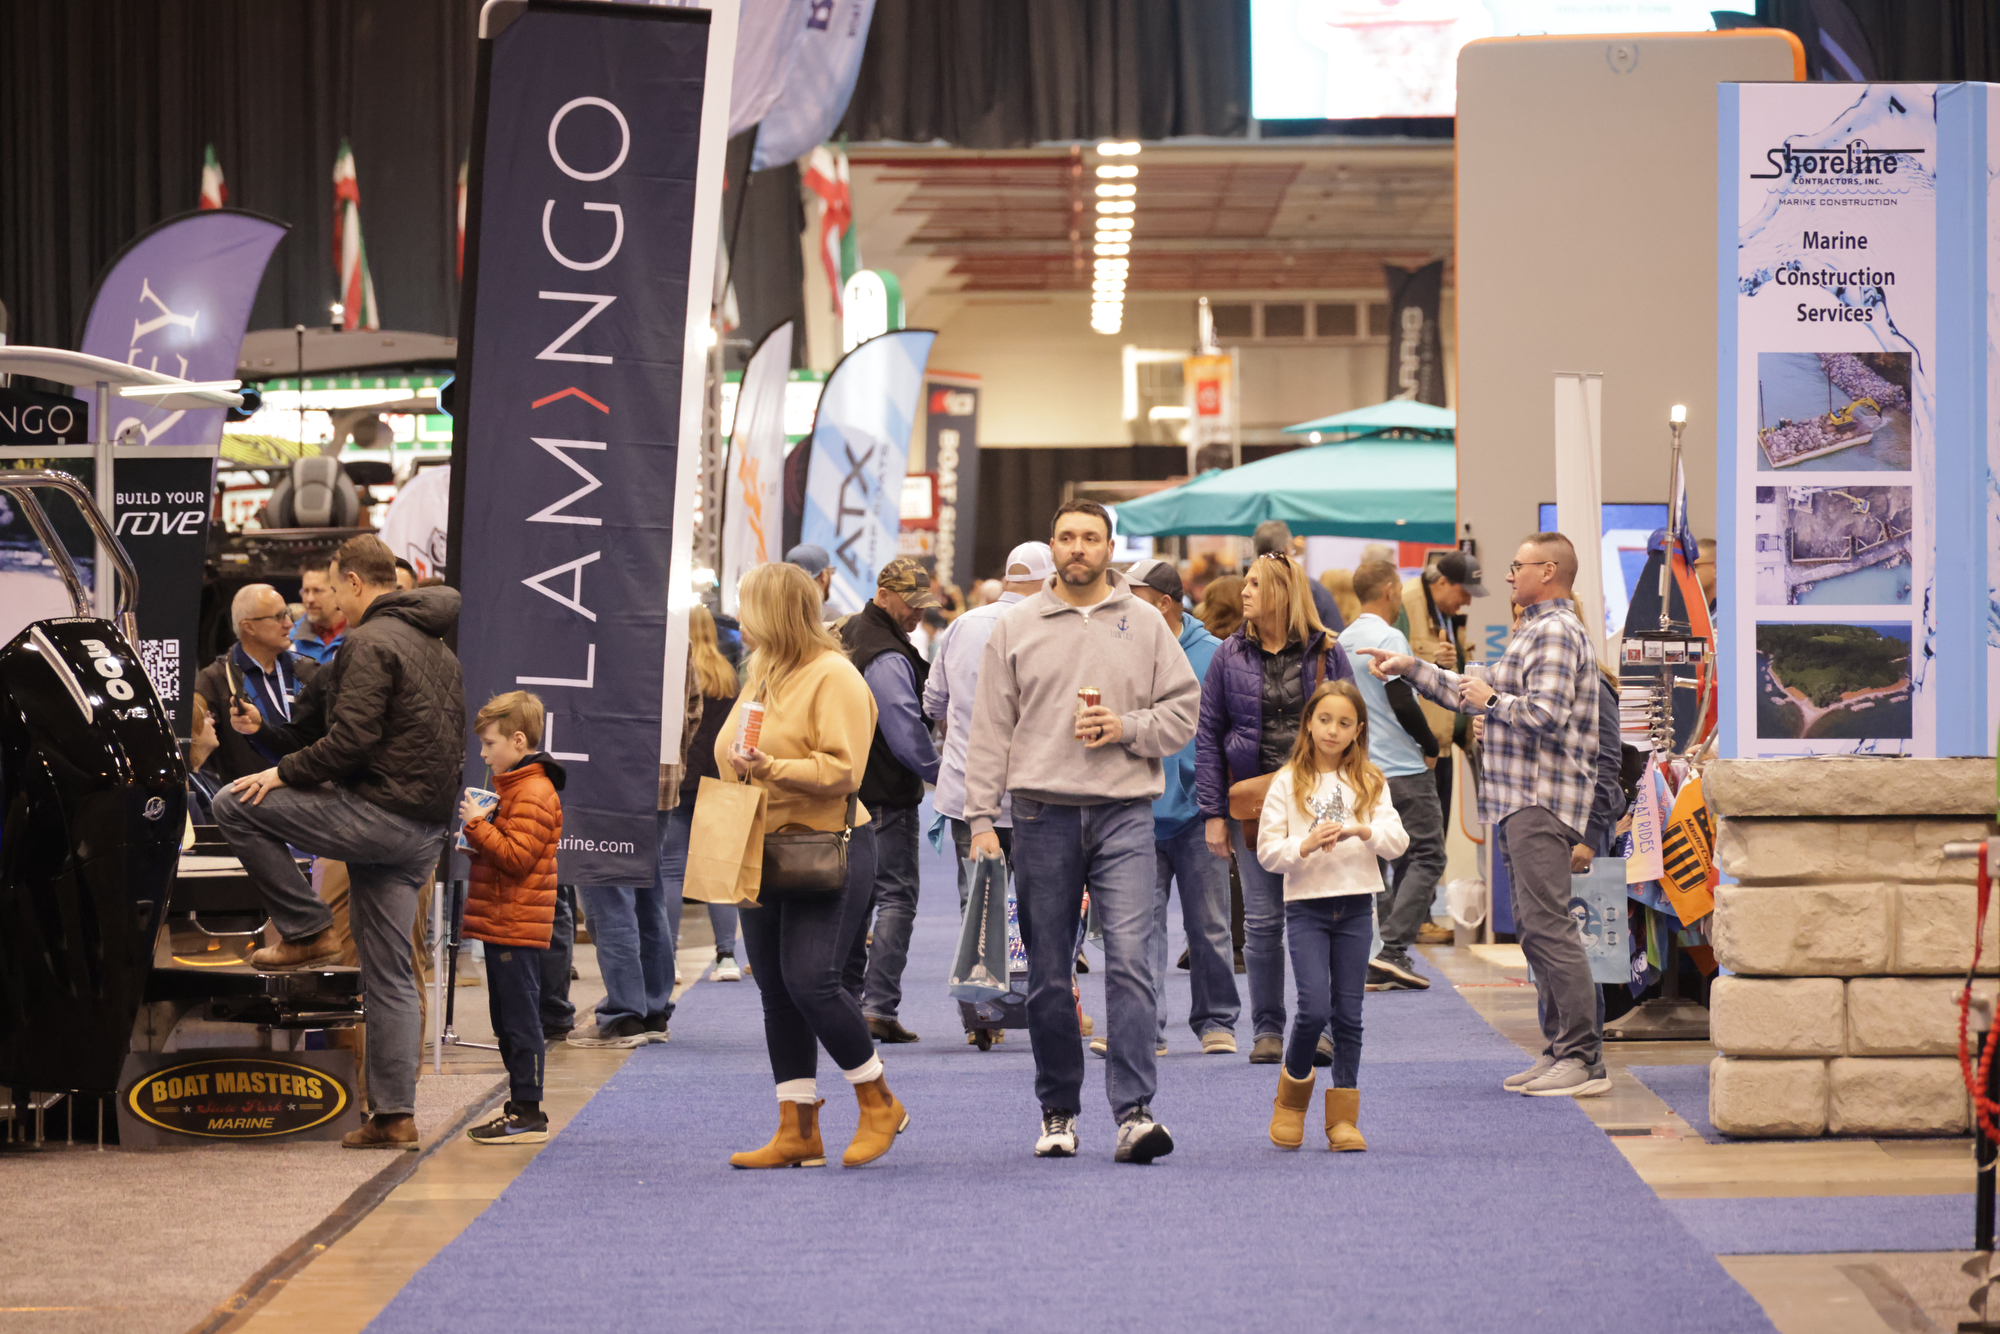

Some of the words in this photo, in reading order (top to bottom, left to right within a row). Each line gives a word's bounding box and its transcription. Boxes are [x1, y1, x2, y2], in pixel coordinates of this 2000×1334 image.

[1756, 142, 1905, 179] Shoreline
[1793, 178, 1862, 186] CONTRACTORS,
[1778, 198, 1817, 206] MARINE
[1819, 198, 1898, 206] CONSTRUCTION
[1802, 230, 1868, 249] Marine
[1775, 267, 1895, 285] Construction
[1797, 303, 1873, 322] Services
[936, 428, 960, 504] BOAT
[116, 493, 161, 505] BUILD
[166, 492, 204, 504] YOUR
[835, 442, 876, 580] ATX
[80, 639, 135, 700] 300
[112, 707, 149, 721] V8
[1637, 821, 1655, 855] RIDES
[151, 1073, 210, 1103] BOAT
[215, 1072, 324, 1100] MASTERS
[207, 1117, 276, 1130] MARINE
